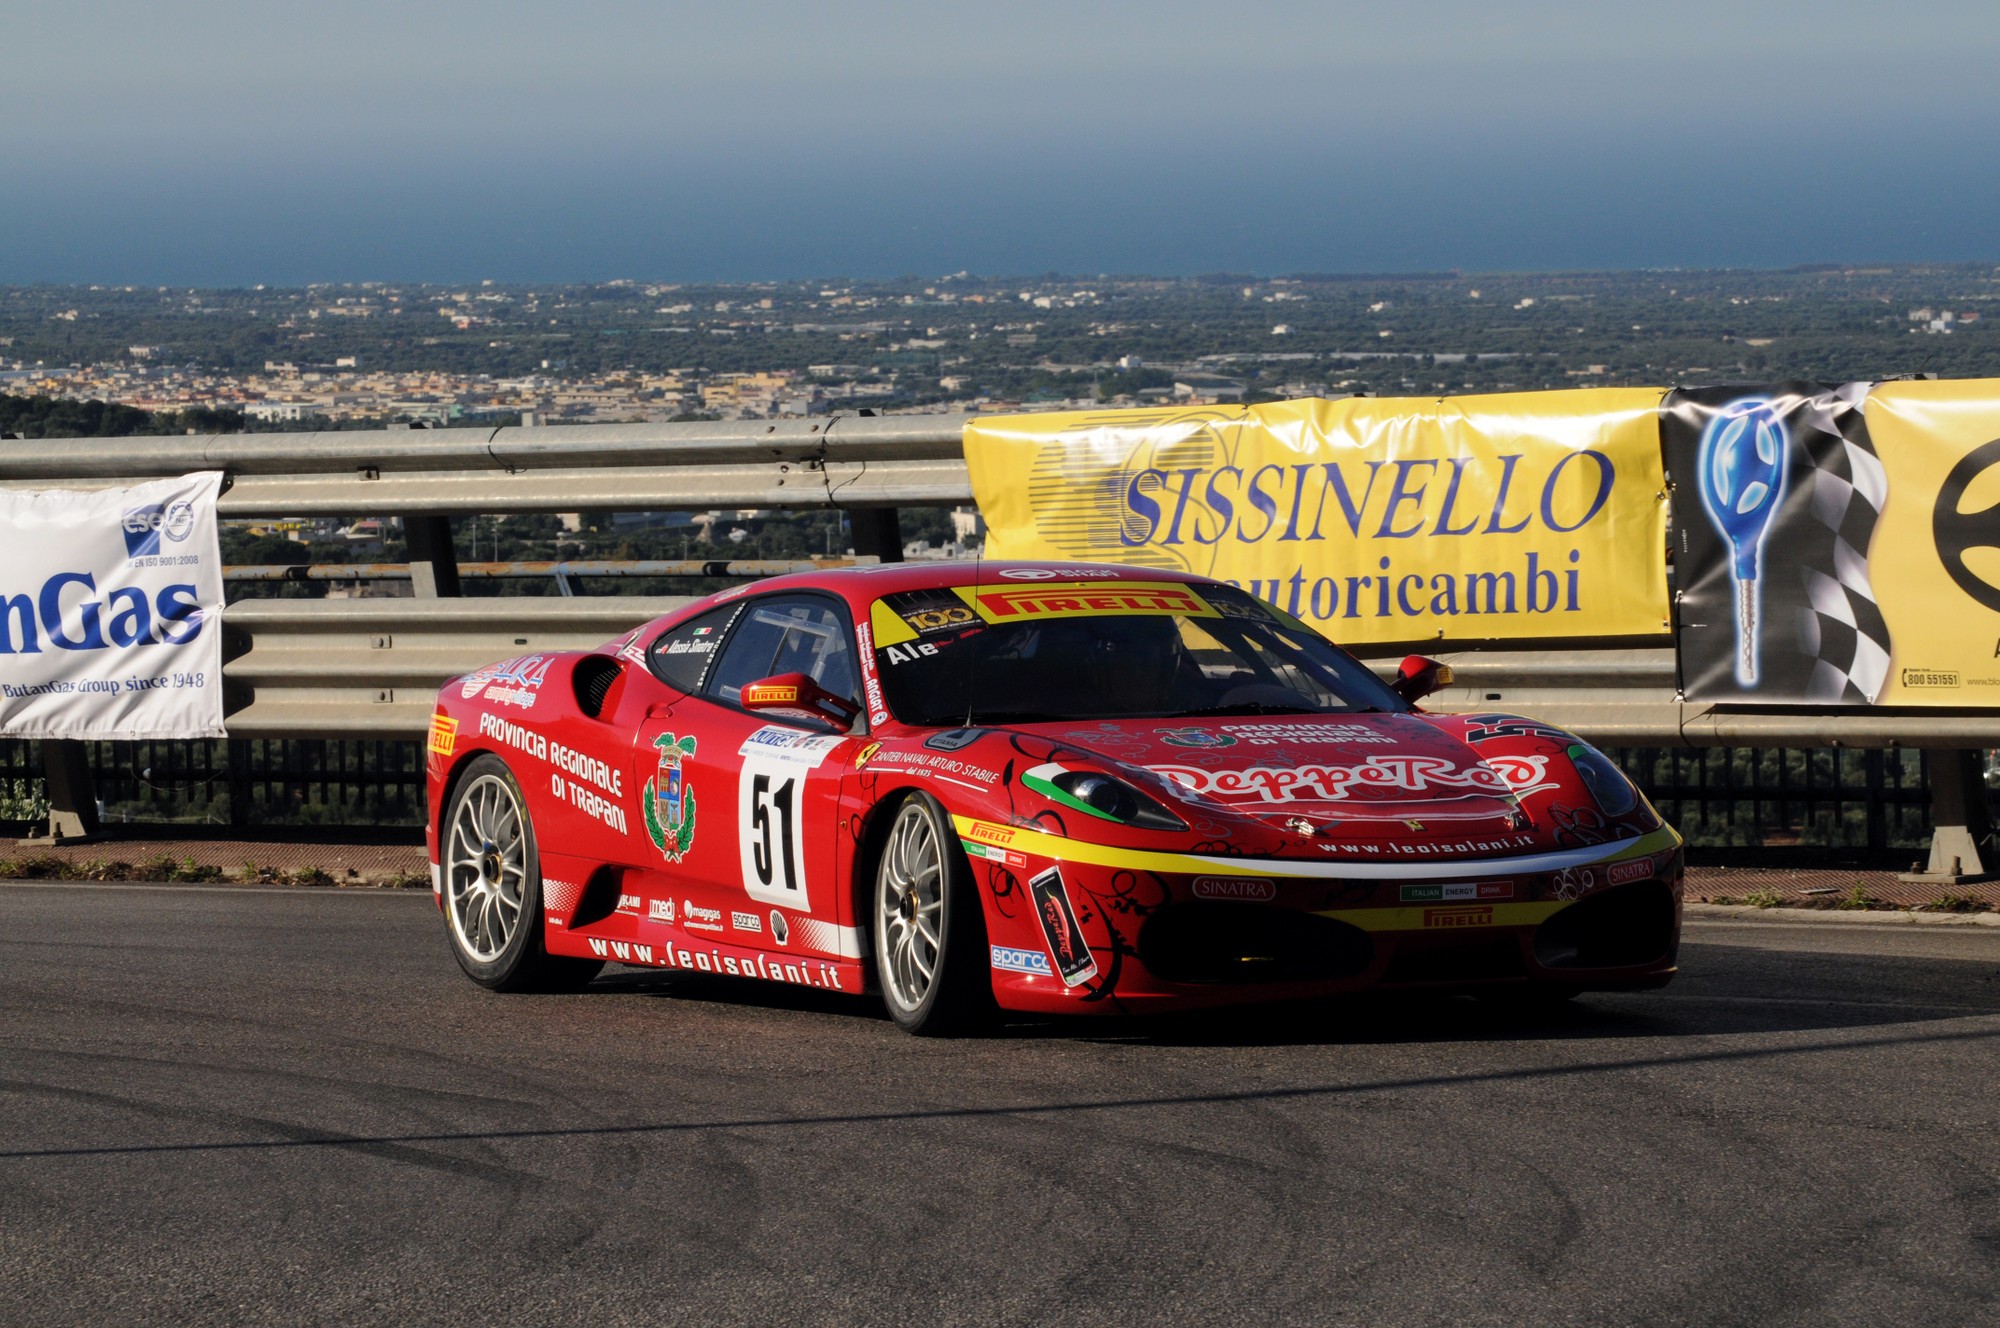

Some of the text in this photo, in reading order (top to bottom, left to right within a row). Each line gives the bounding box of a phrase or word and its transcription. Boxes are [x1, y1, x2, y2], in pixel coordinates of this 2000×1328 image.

[1119, 449, 1616, 548] SISSINELLO
[146, 557, 157, 567] ISO
[159, 555, 199, 566] 9001:2008
[976, 588, 1203, 615] PIRELLI
[886, 642, 939, 666] Ale
[2, 673, 204, 698] ButanGas Group since 1948
[1908, 674, 1958, 685] 800 551551
[751, 688, 796, 700] PIRELLI
[1220, 724, 1370, 732] PROVINCIA
[1235, 731, 1384, 739] REGIONALE
[1280, 737, 1398, 745] TRAPANI
[480, 712, 547, 760] PROVINCIA
[550, 741, 622, 798] REGIONALE
[872, 751, 999, 784] CANTIERI NAVALI ARTURO STABILE
[551, 773, 567, 802] DI
[567, 779, 627, 836] TRAPANI
[752, 774, 797, 891] 51
[970, 822, 1016, 844] PIRELLI
[1317, 835, 1535, 855] www.leoisolani.it
[987, 850, 1004, 859] ENERGY
[1009, 855, 1023, 864] DRINK
[1613, 863, 1650, 881] SINATRA
[1201, 880, 1268, 898] SINATRA
[1411, 886, 1501, 897] ITALIAN ENERGY DRINK
[733, 914, 760, 928] sparco
[1424, 906, 1494, 928] PIRELLI
